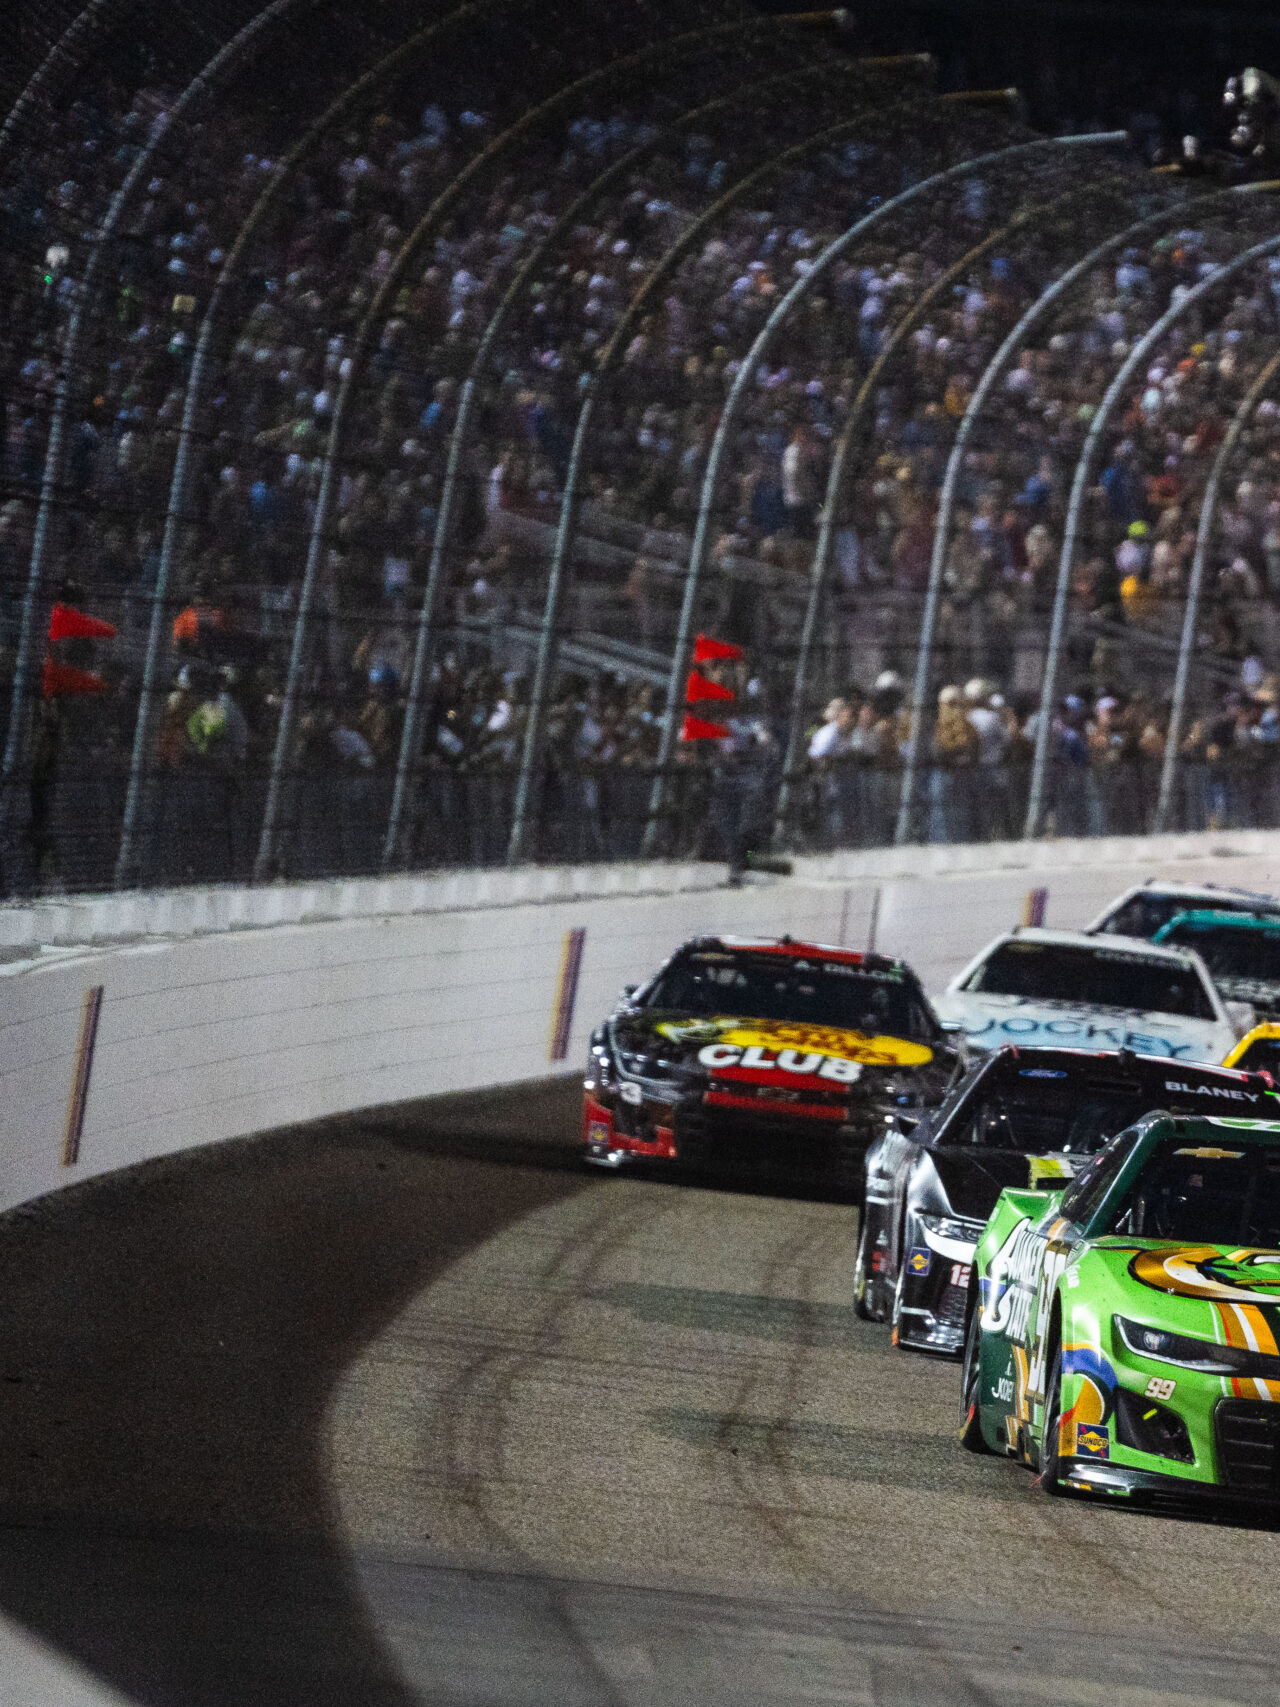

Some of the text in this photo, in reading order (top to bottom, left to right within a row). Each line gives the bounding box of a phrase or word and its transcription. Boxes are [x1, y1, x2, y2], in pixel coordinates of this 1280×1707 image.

[967, 1018, 1191, 1059] JOCKEY
[698, 1044, 863, 1083] CLUB
[620, 1081, 642, 1105] 3
[1165, 1081, 1259, 1102] BLANEY
[950, 1263, 971, 1288] 12
[1144, 1377, 1176, 1400] 99
[1078, 1435, 1108, 1447] SUNOCO
